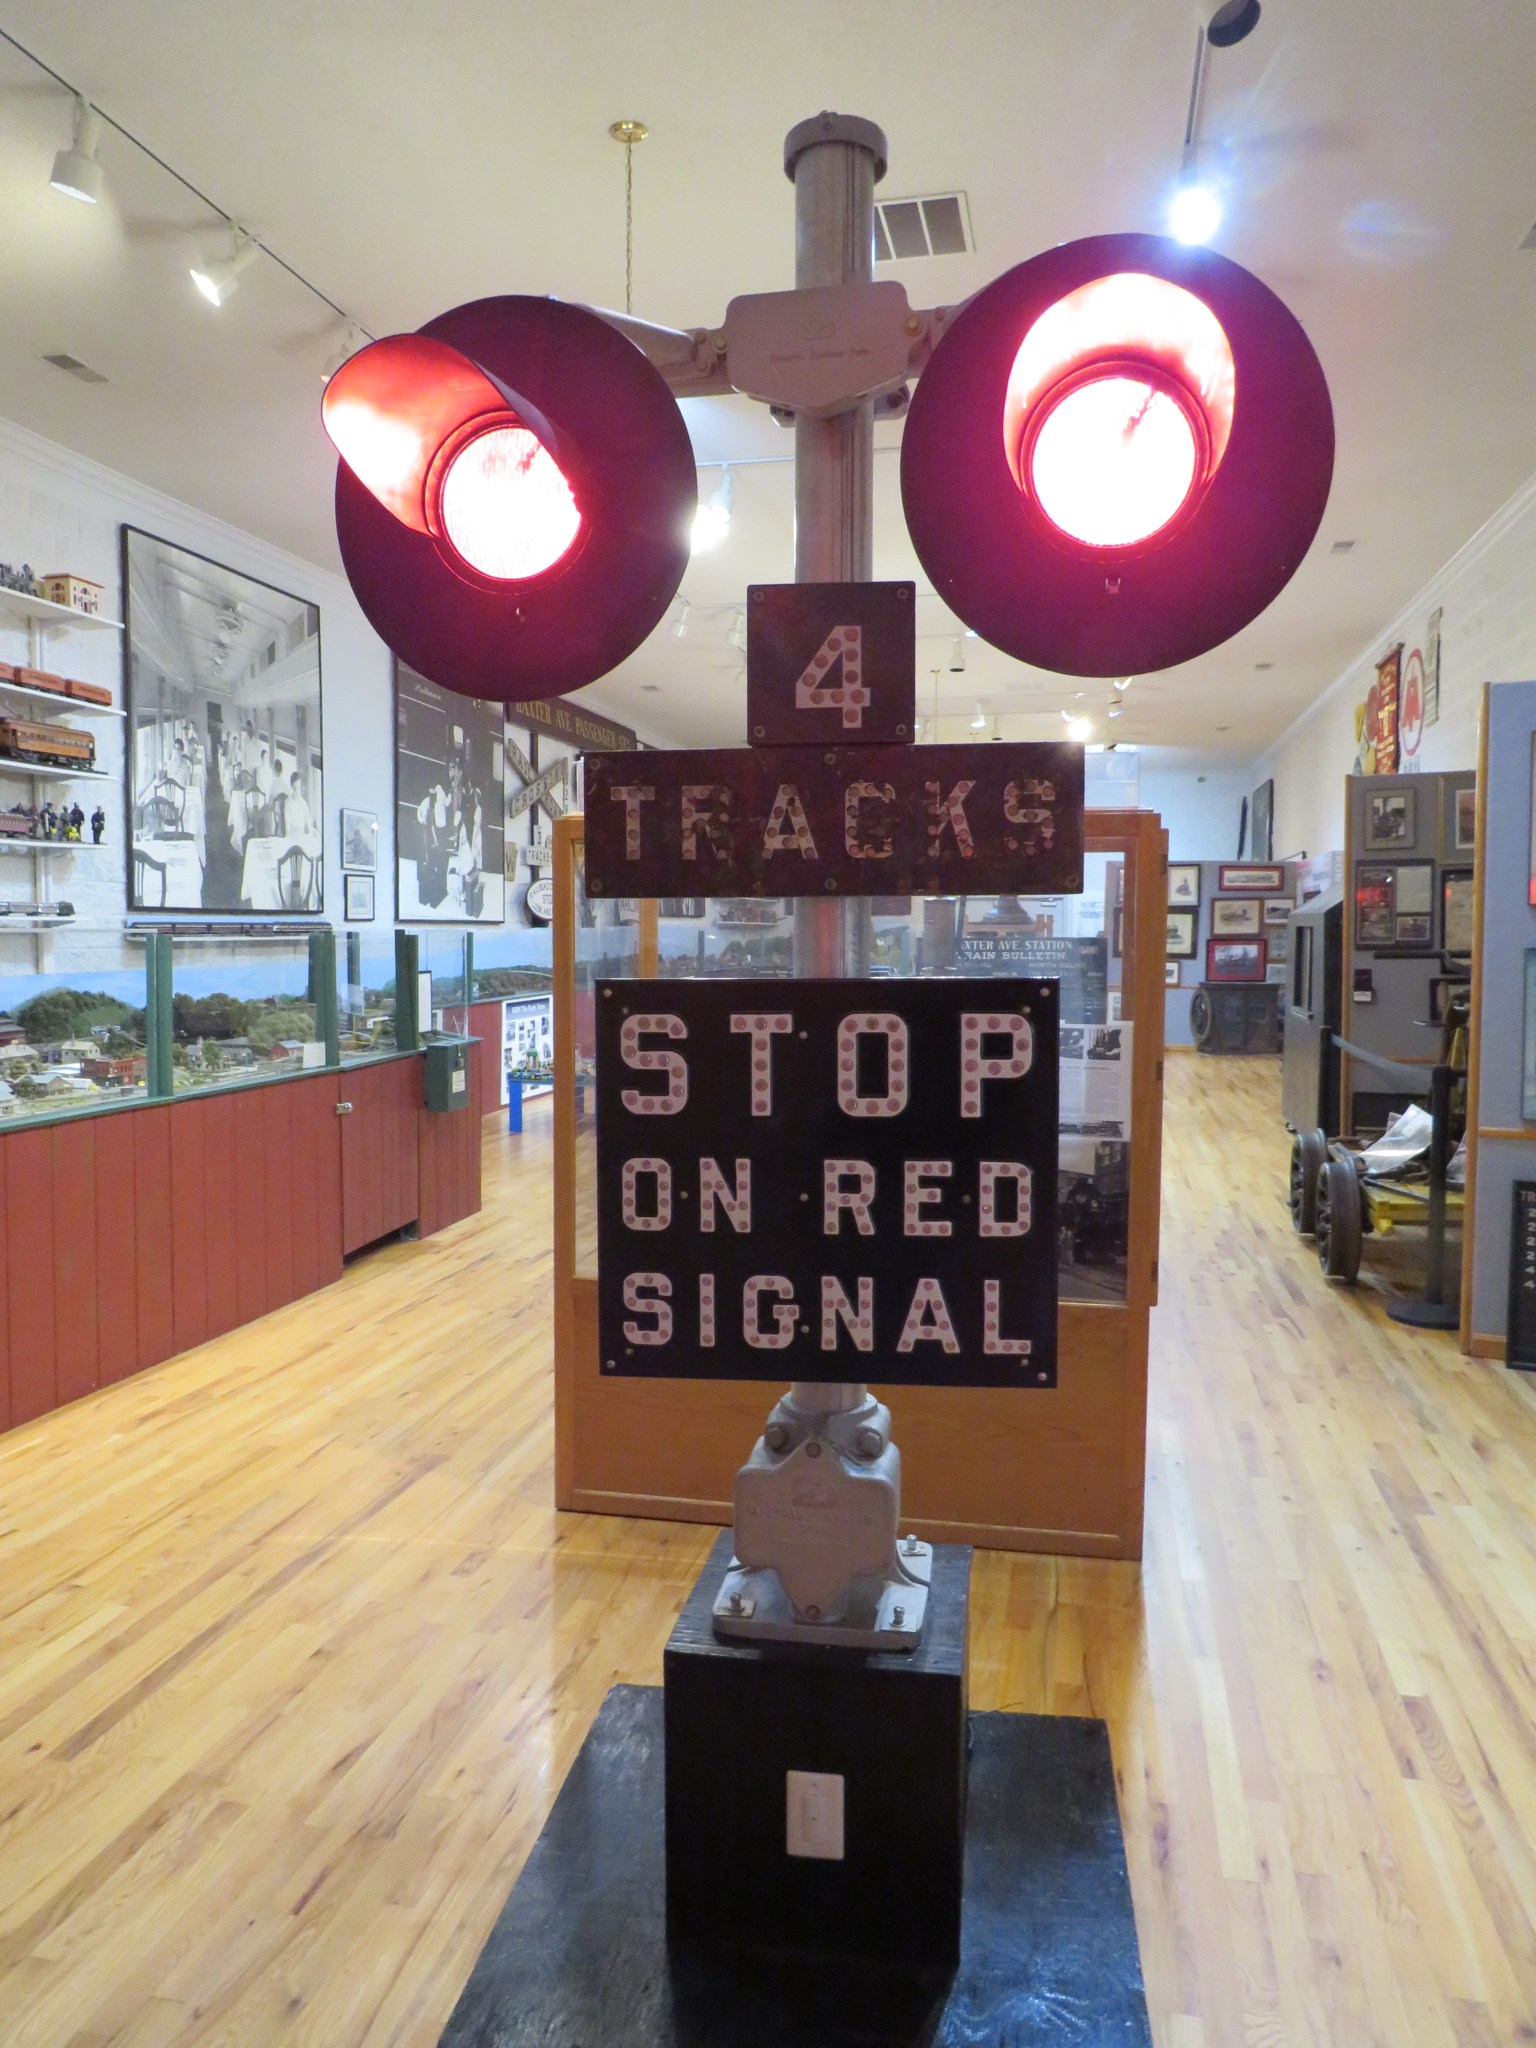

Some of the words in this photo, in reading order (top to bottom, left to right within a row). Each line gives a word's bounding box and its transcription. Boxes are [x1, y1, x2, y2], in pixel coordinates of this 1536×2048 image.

[793, 623, 873, 731] 4
[575, 717, 616, 749] PASSENGER
[609, 778, 1057, 862] TRACKS
[542, 894, 553, 905] STO
[1025, 940, 1073, 951] STATION
[620, 1012, 1033, 1118] STOP
[621, 1156, 752, 1234] ON
[823, 1159, 1033, 1238] RED
[622, 1271, 1033, 1356] SIGNAL
